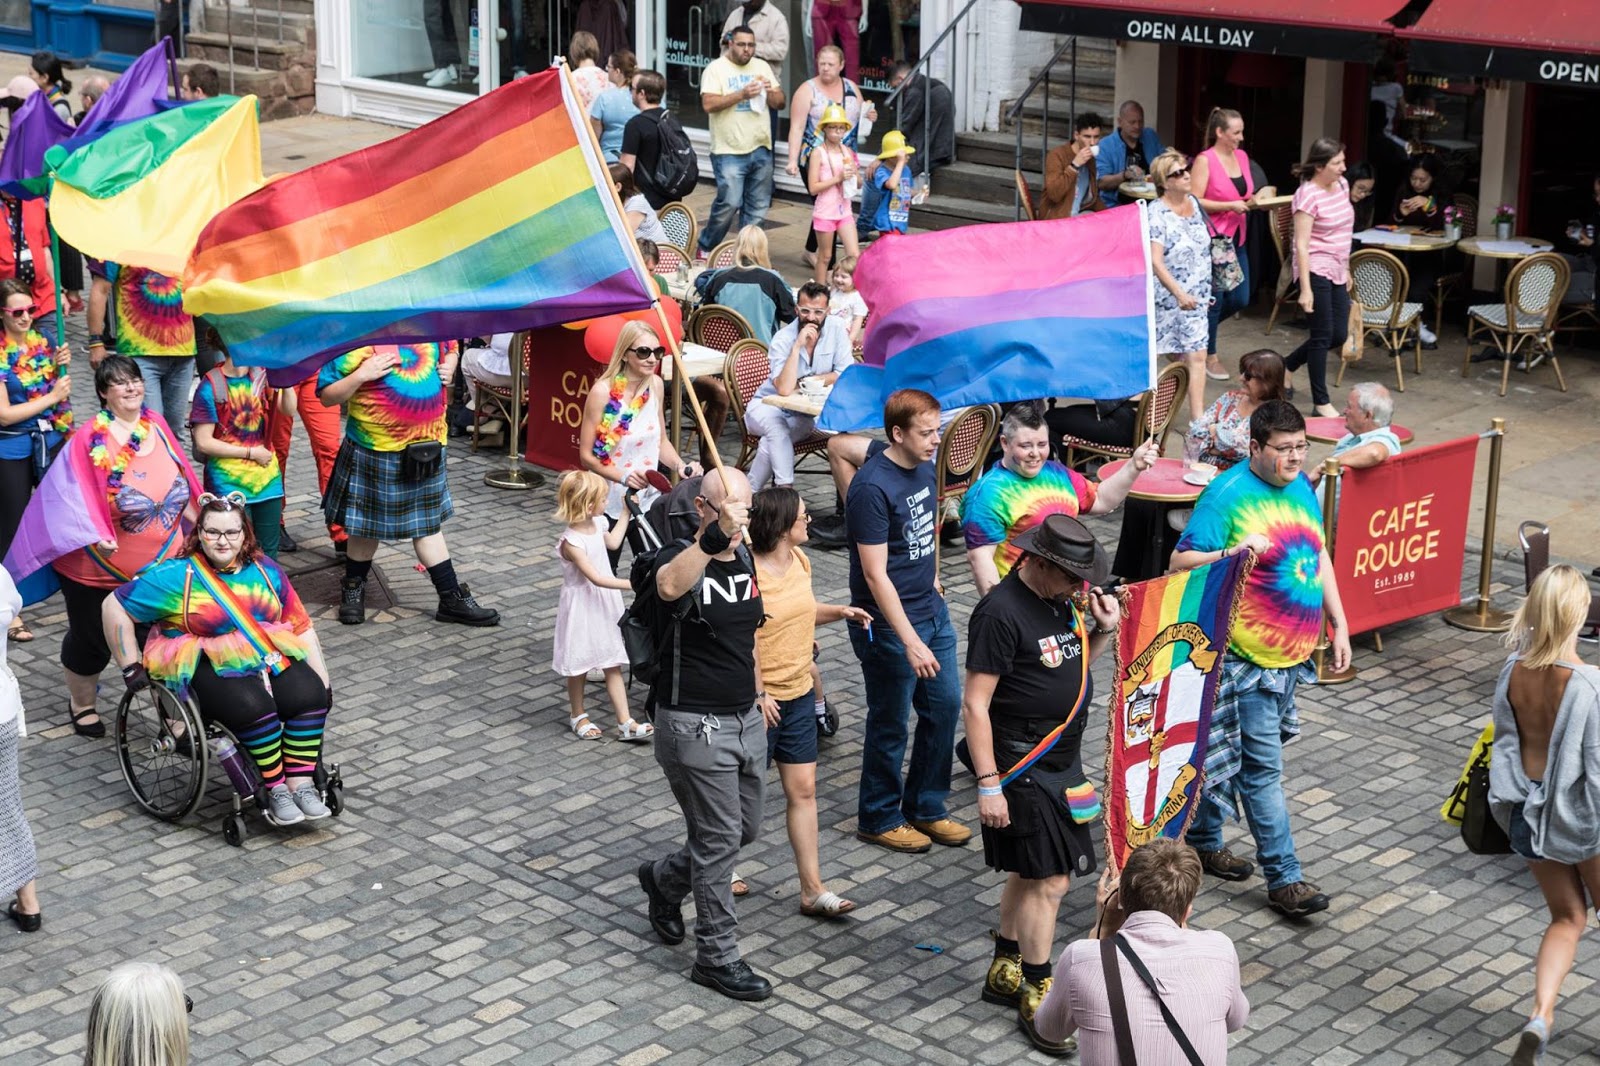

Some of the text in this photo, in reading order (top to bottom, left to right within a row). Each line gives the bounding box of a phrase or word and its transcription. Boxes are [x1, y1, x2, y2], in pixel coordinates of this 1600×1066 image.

[665, 38, 688, 50] New
[1127, 20, 1254, 48] OPEN ALL DAY
[665, 51, 711, 65] collectio
[1540, 60, 1600, 83] OPEN
[876, 79, 894, 91] sto
[562, 370, 590, 398] CA
[551, 396, 582, 428] RO
[1368, 492, 1435, 538] CAFÉ
[1353, 529, 1441, 578] ROUGE
[703, 573, 752, 605] N7
[1374, 570, 1415, 589] Est. 1989
[1056, 631, 1076, 644] Unive
[1062, 643, 1082, 660] Che
